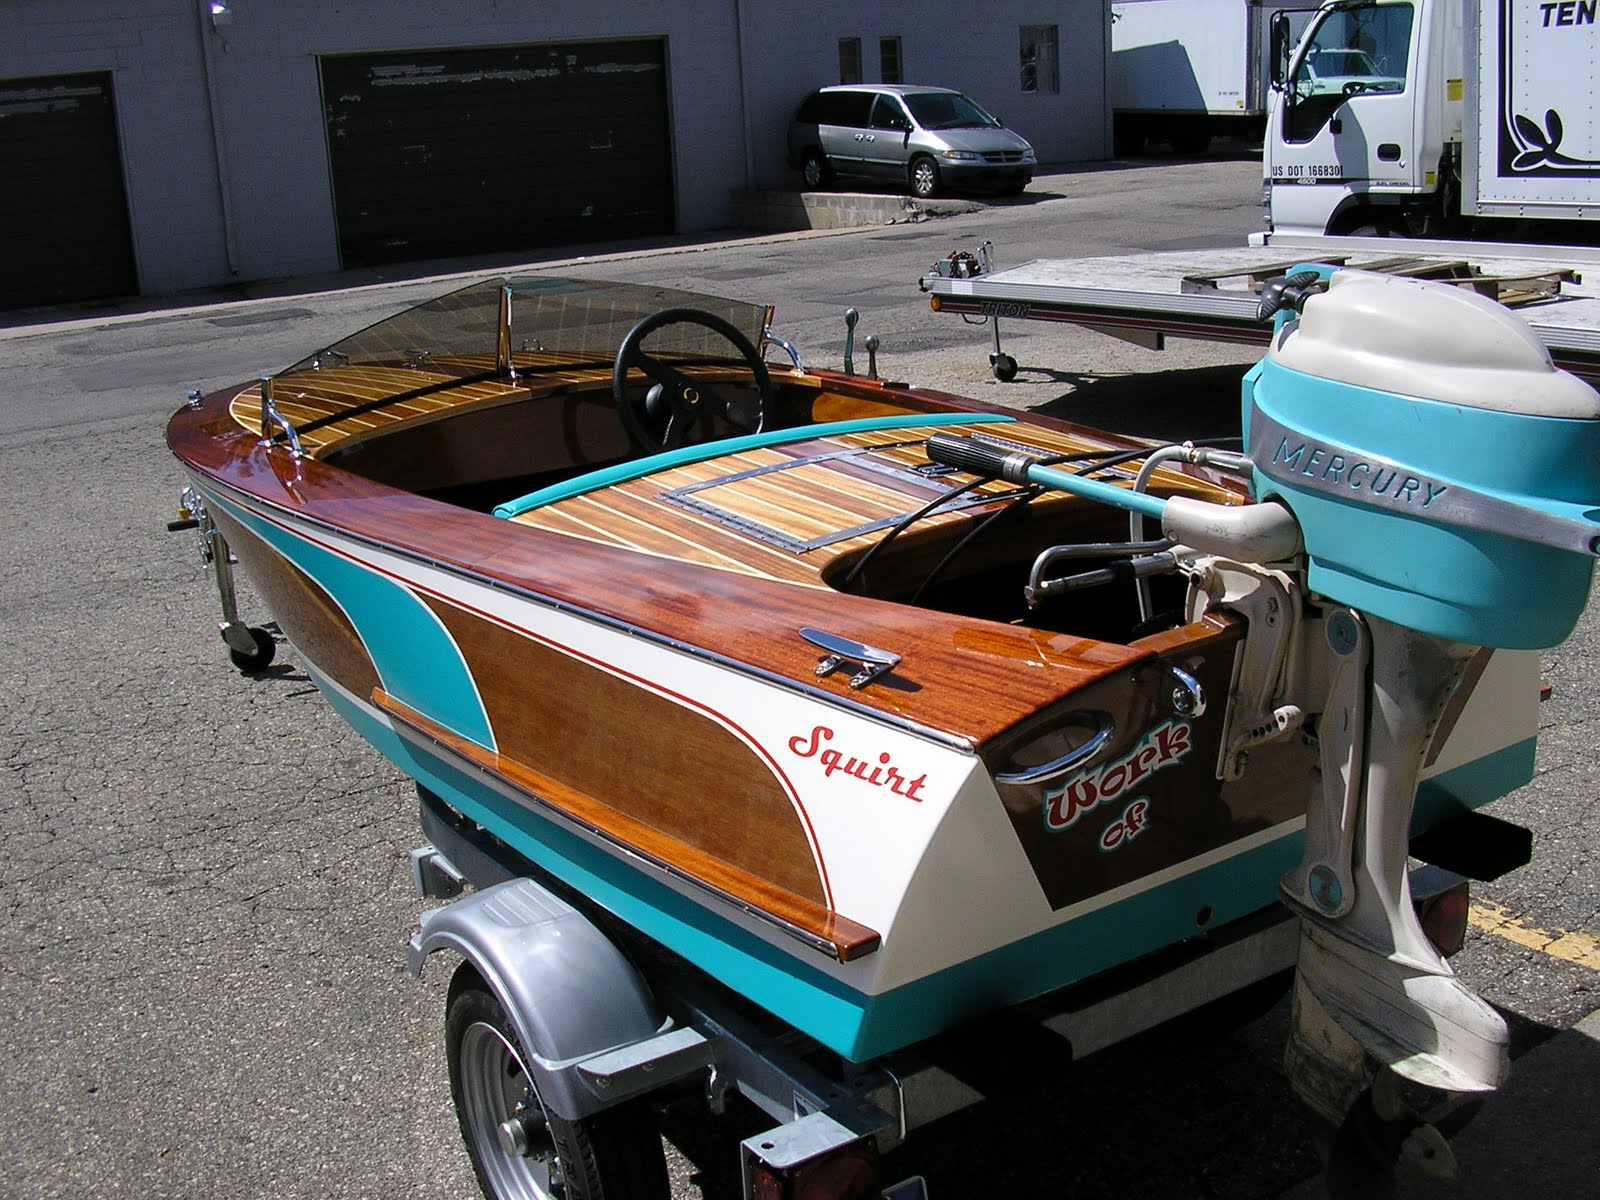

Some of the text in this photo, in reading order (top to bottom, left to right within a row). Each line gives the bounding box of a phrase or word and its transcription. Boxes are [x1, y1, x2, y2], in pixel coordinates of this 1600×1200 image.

[1540, 1, 1597, 28] TEN
[1272, 165, 1344, 177] US DOT 1668301
[981, 300, 1031, 318] TRITON
[1272, 436, 1448, 508] MERCURY
[788, 725, 926, 803] Squirt
[1043, 720, 1193, 832] Work
[1099, 798, 1150, 853] of
